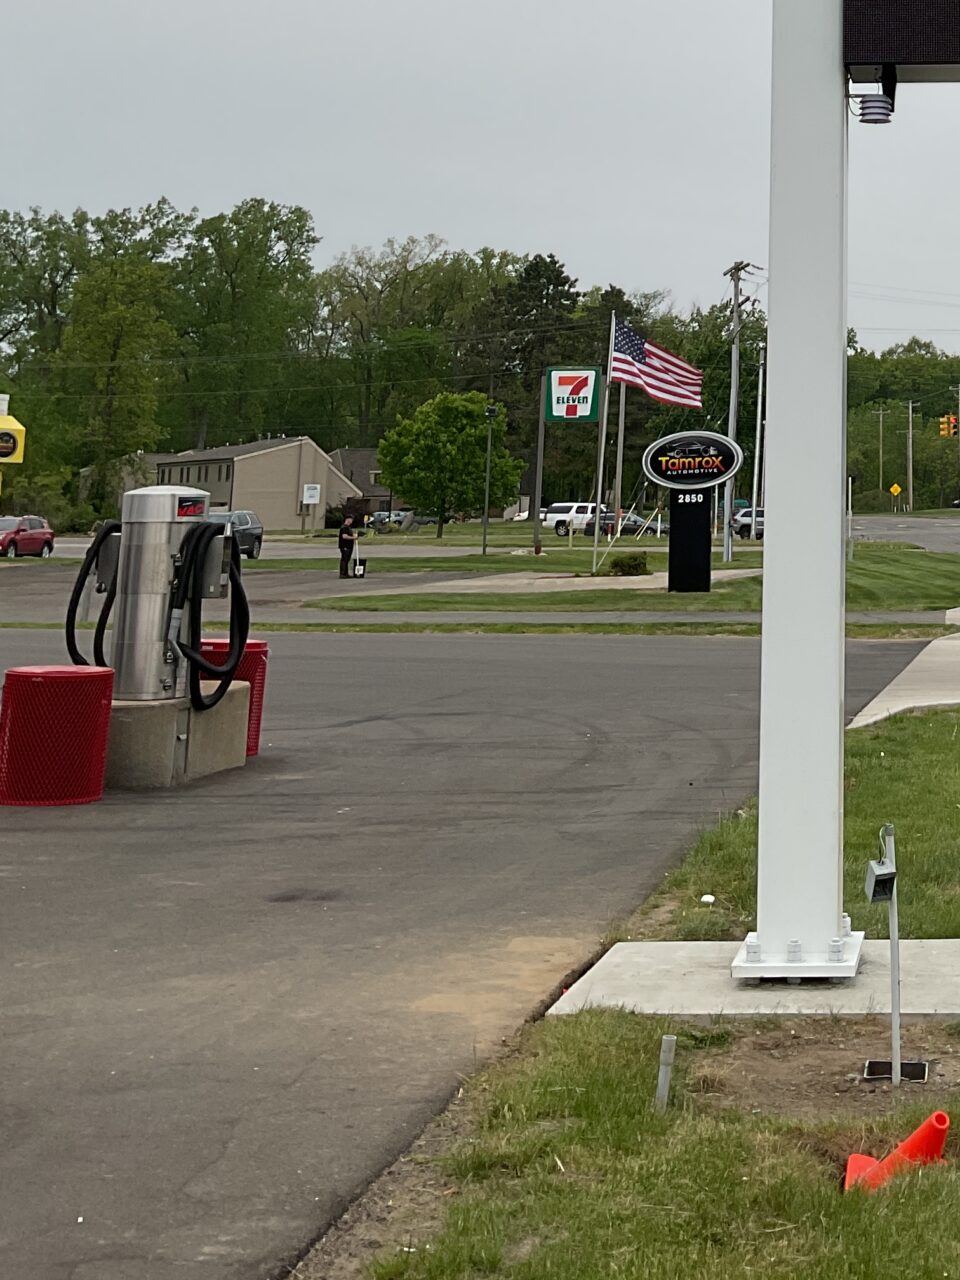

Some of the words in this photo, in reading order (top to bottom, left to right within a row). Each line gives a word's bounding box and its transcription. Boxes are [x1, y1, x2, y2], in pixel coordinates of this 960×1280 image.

[558, 376, 589, 417] 7
[658, 456, 726, 471] Tamrox
[677, 493, 704, 503] 2850
